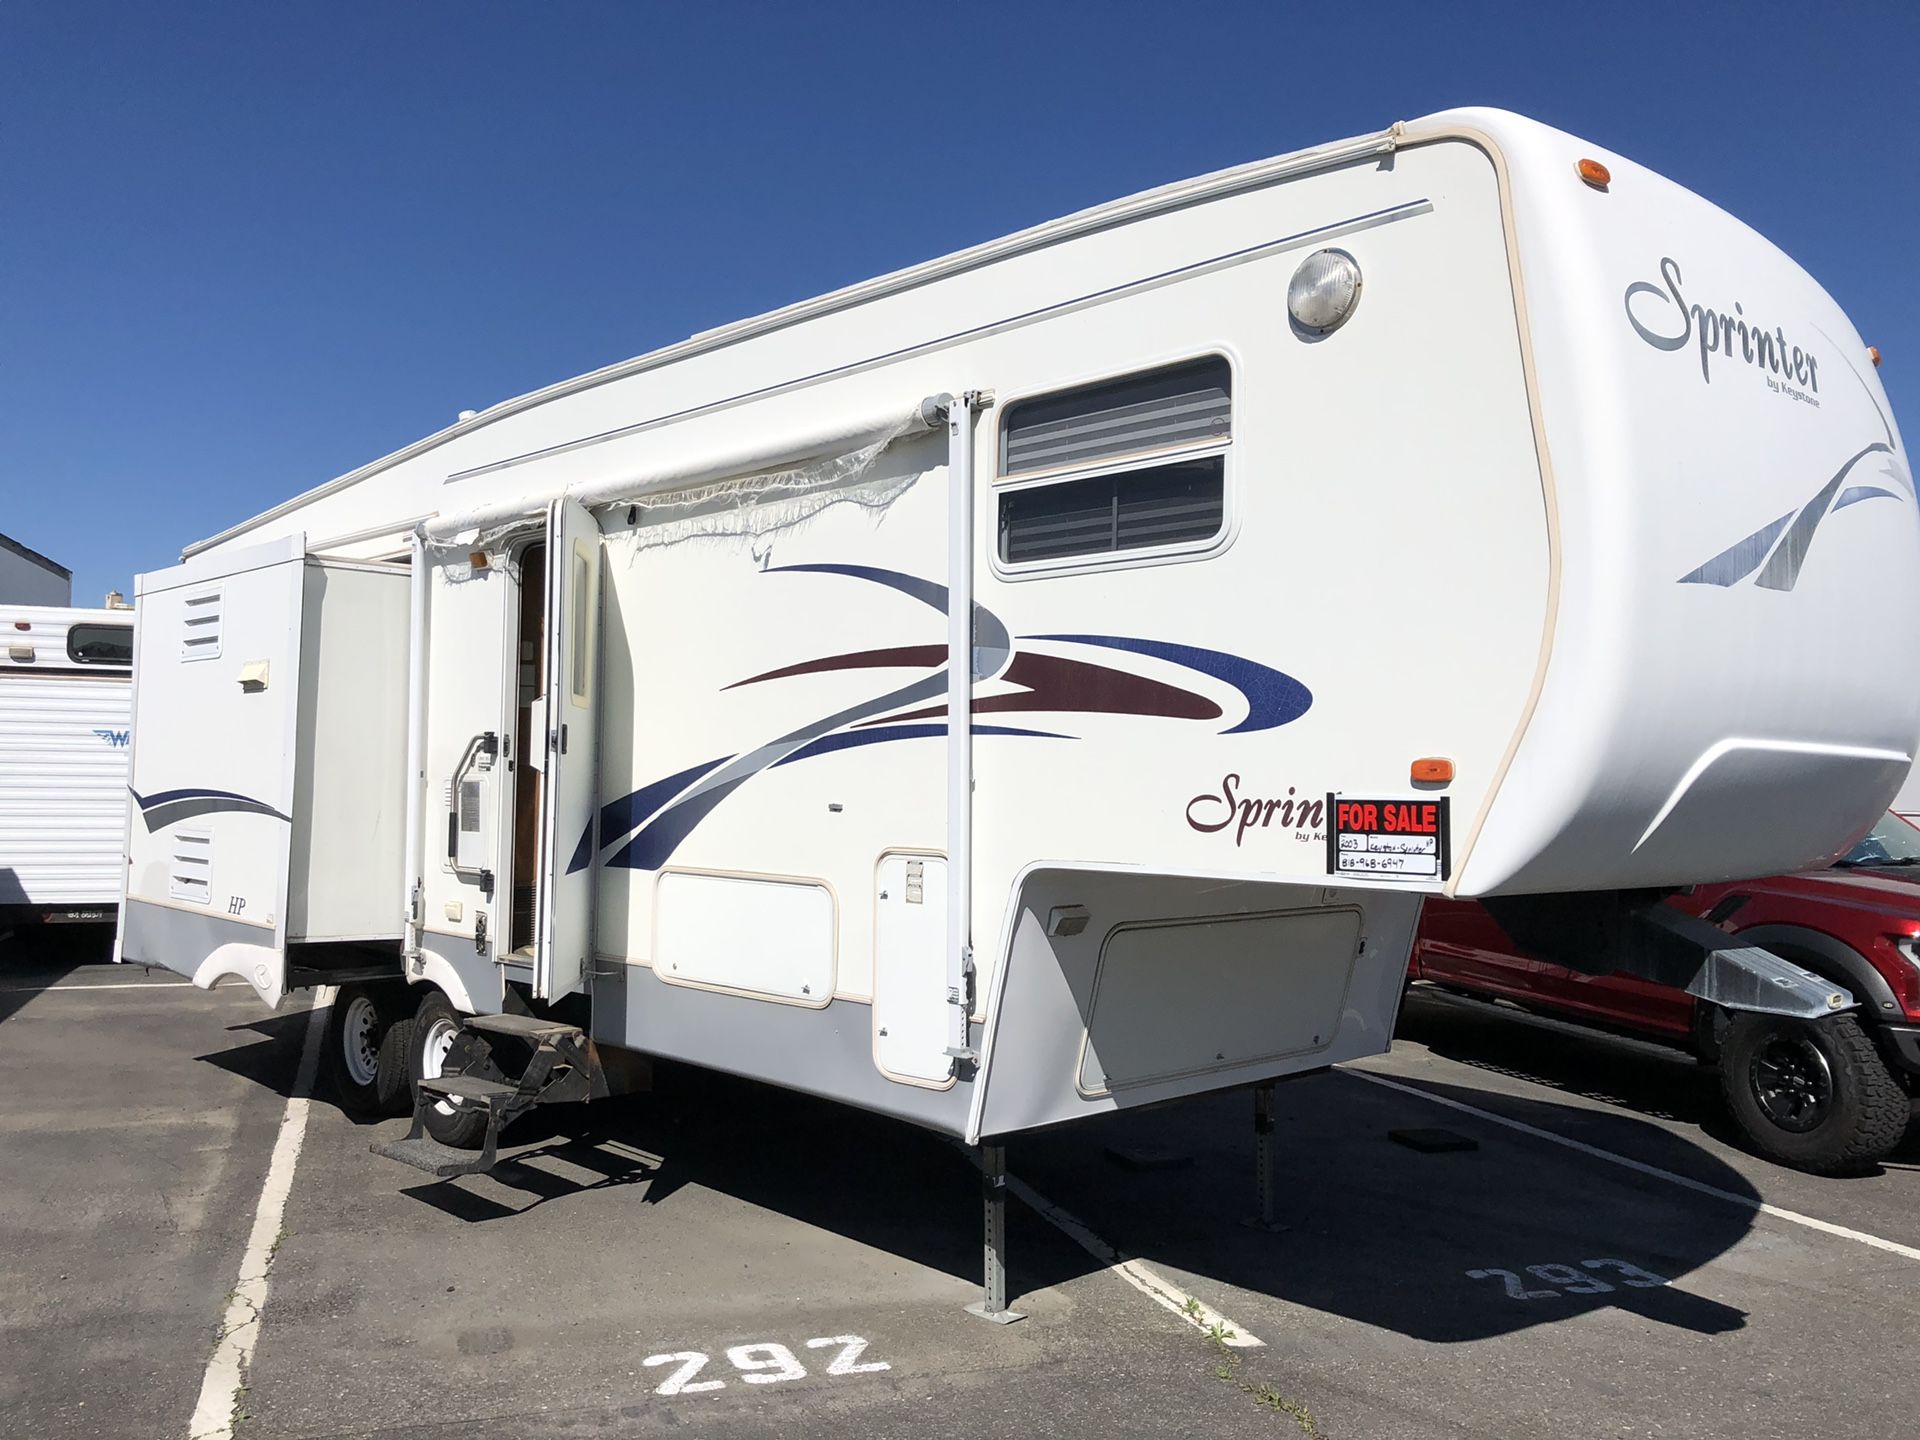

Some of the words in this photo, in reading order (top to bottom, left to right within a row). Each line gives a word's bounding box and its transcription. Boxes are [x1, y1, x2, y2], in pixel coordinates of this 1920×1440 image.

[1625, 256, 1818, 393] Sprinter
[1766, 375, 1780, 393] by
[1781, 381, 1821, 408] Keystone
[1186, 773, 1324, 847] Sprin
[1338, 803, 1378, 831] FOR
[1383, 804, 1437, 832] SALE
[1295, 831, 1310, 842] by
[228, 896, 246, 915] HP
[1465, 1258, 1673, 1300] 293
[642, 1334, 892, 1395] 292
